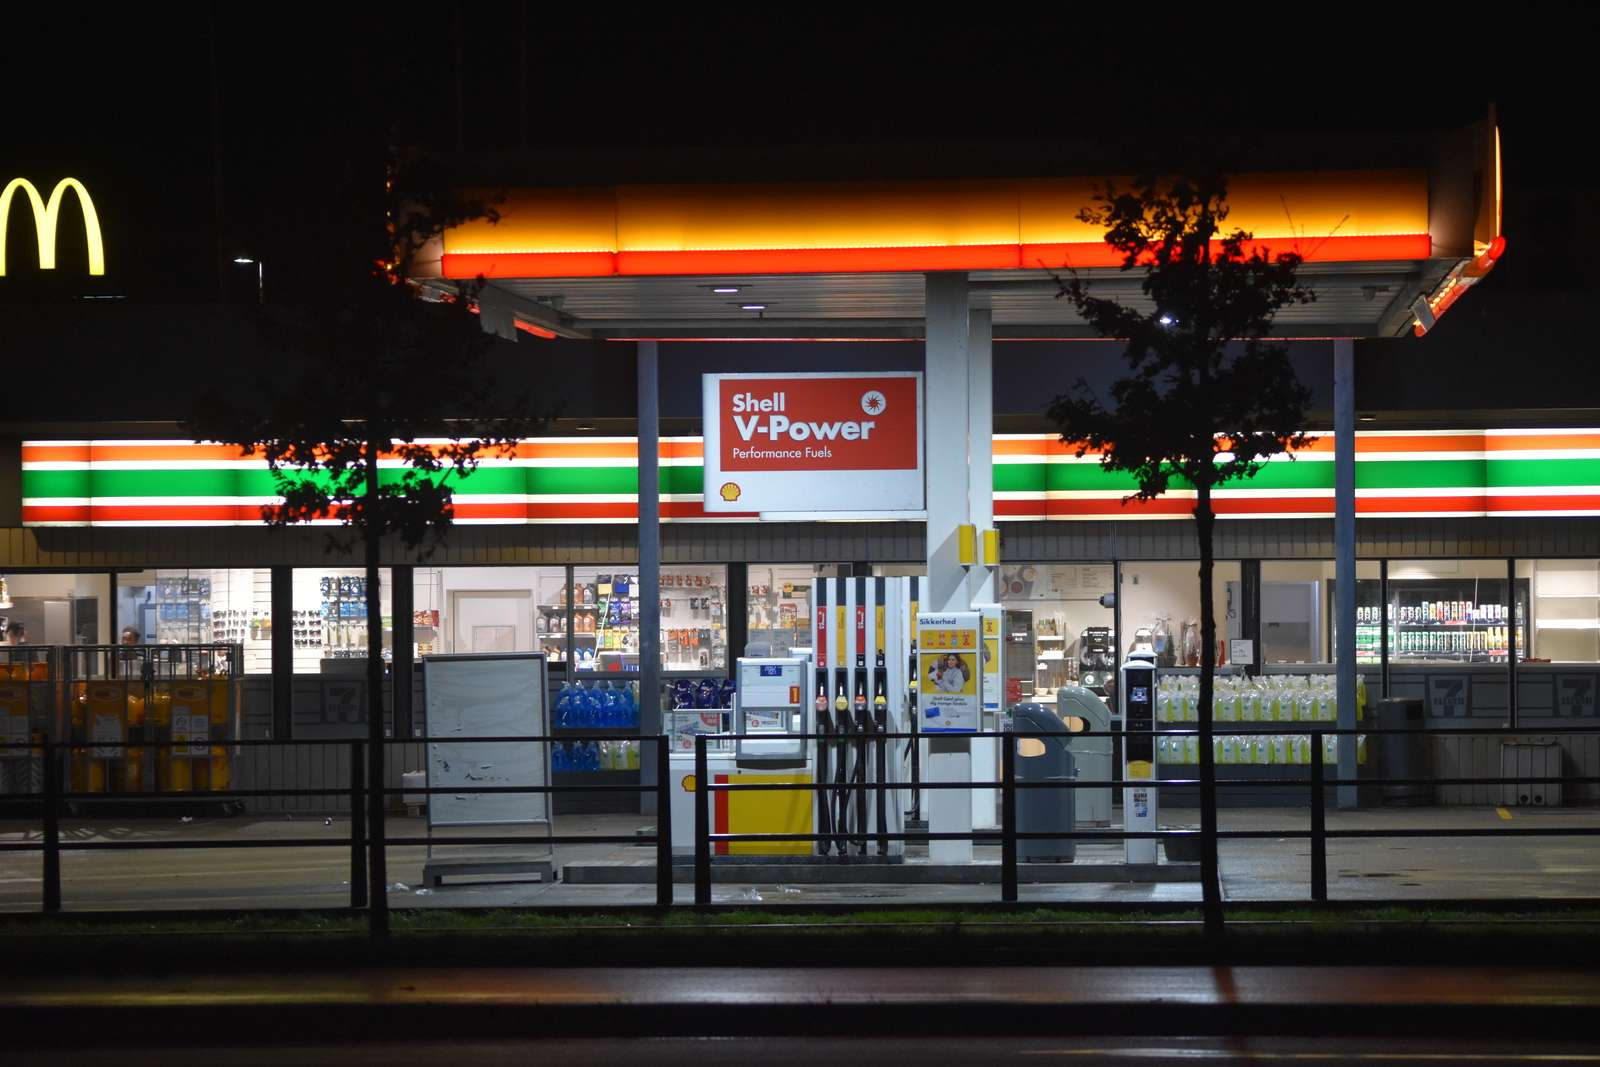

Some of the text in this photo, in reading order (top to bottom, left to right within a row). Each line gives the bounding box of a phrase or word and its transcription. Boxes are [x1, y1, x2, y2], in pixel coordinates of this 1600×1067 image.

[732, 392, 786, 413] Shell
[733, 415, 876, 441] V-Power
[733, 446, 832, 459] Performance Fuels
[919, 617, 957, 625] Sikkerhed
